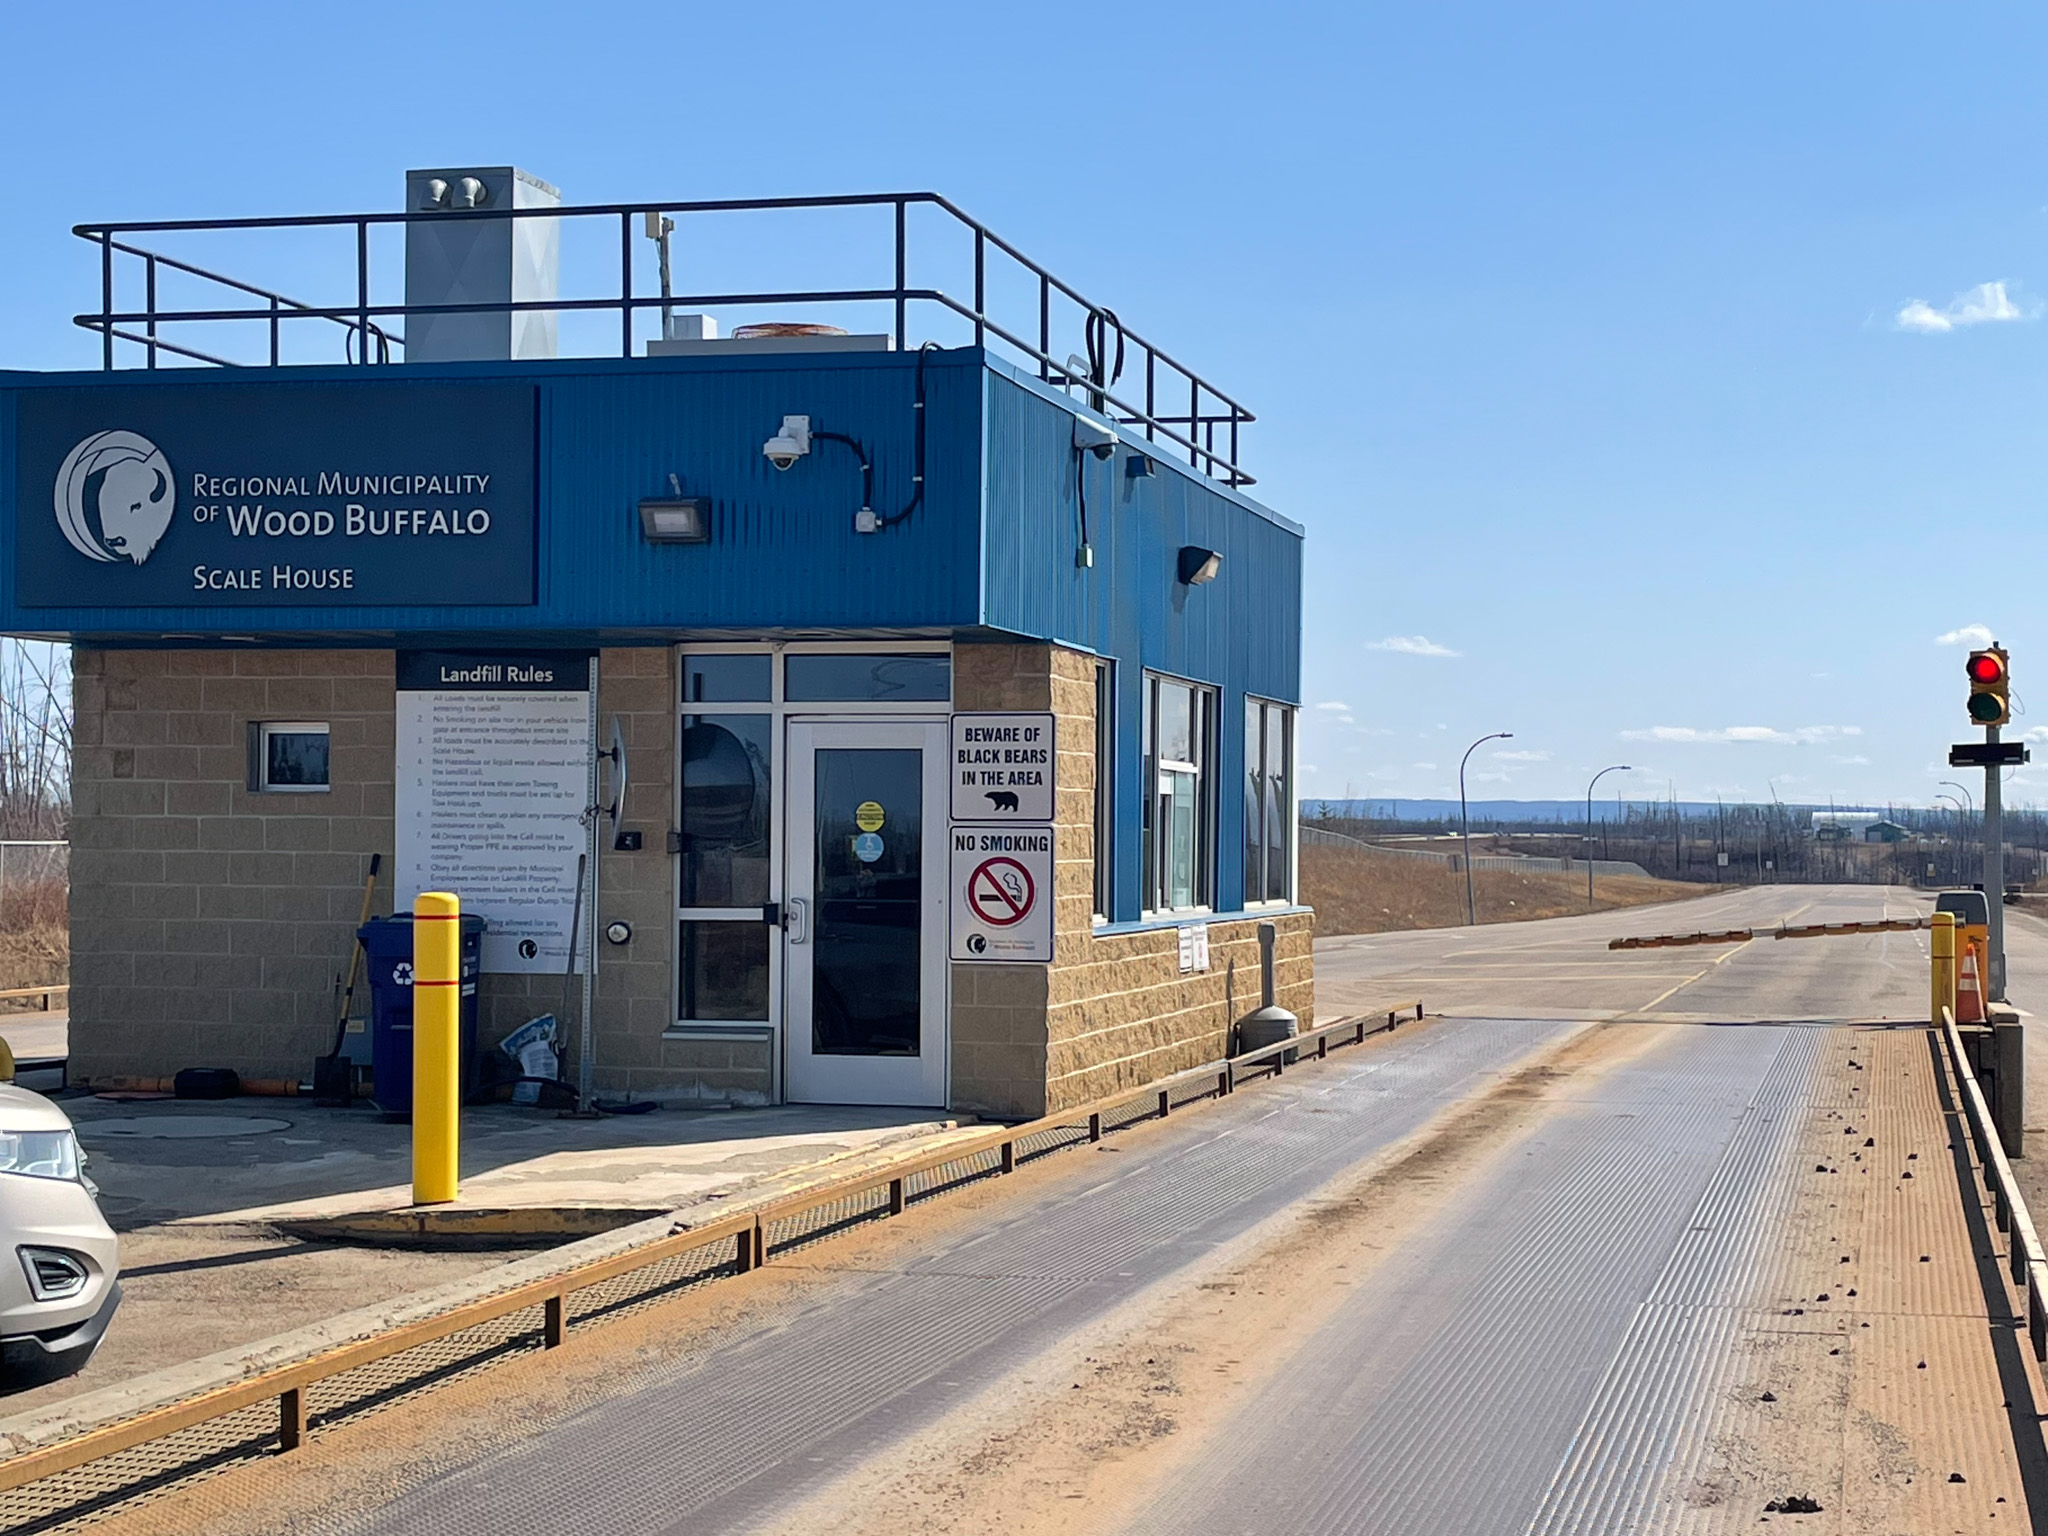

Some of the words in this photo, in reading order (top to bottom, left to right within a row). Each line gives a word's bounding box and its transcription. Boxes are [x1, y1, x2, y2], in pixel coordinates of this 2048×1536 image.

[193, 473, 311, 497] REGIONAL
[317, 471, 491, 495] MUNICIPALITY
[193, 505, 219, 523] OF
[226, 505, 335, 537] WOOD
[345, 504, 491, 536] BUFFALO
[193, 565, 262, 590] SCALE
[272, 565, 354, 590] HOUSE
[441, 665, 502, 682] Landfill
[507, 665, 553, 682] Rules
[965, 728, 1020, 742] BEWARE
[1024, 728, 1041, 742] OF
[958, 749, 1001, 764] BLACK
[1004, 749, 1047, 764] BEARS
[962, 771, 976, 785] IN
[980, 771, 1004, 785] THE
[1008, 771, 1043, 785] AREA
[955, 835, 976, 852] NO
[980, 835, 1048, 852] SMOKING
